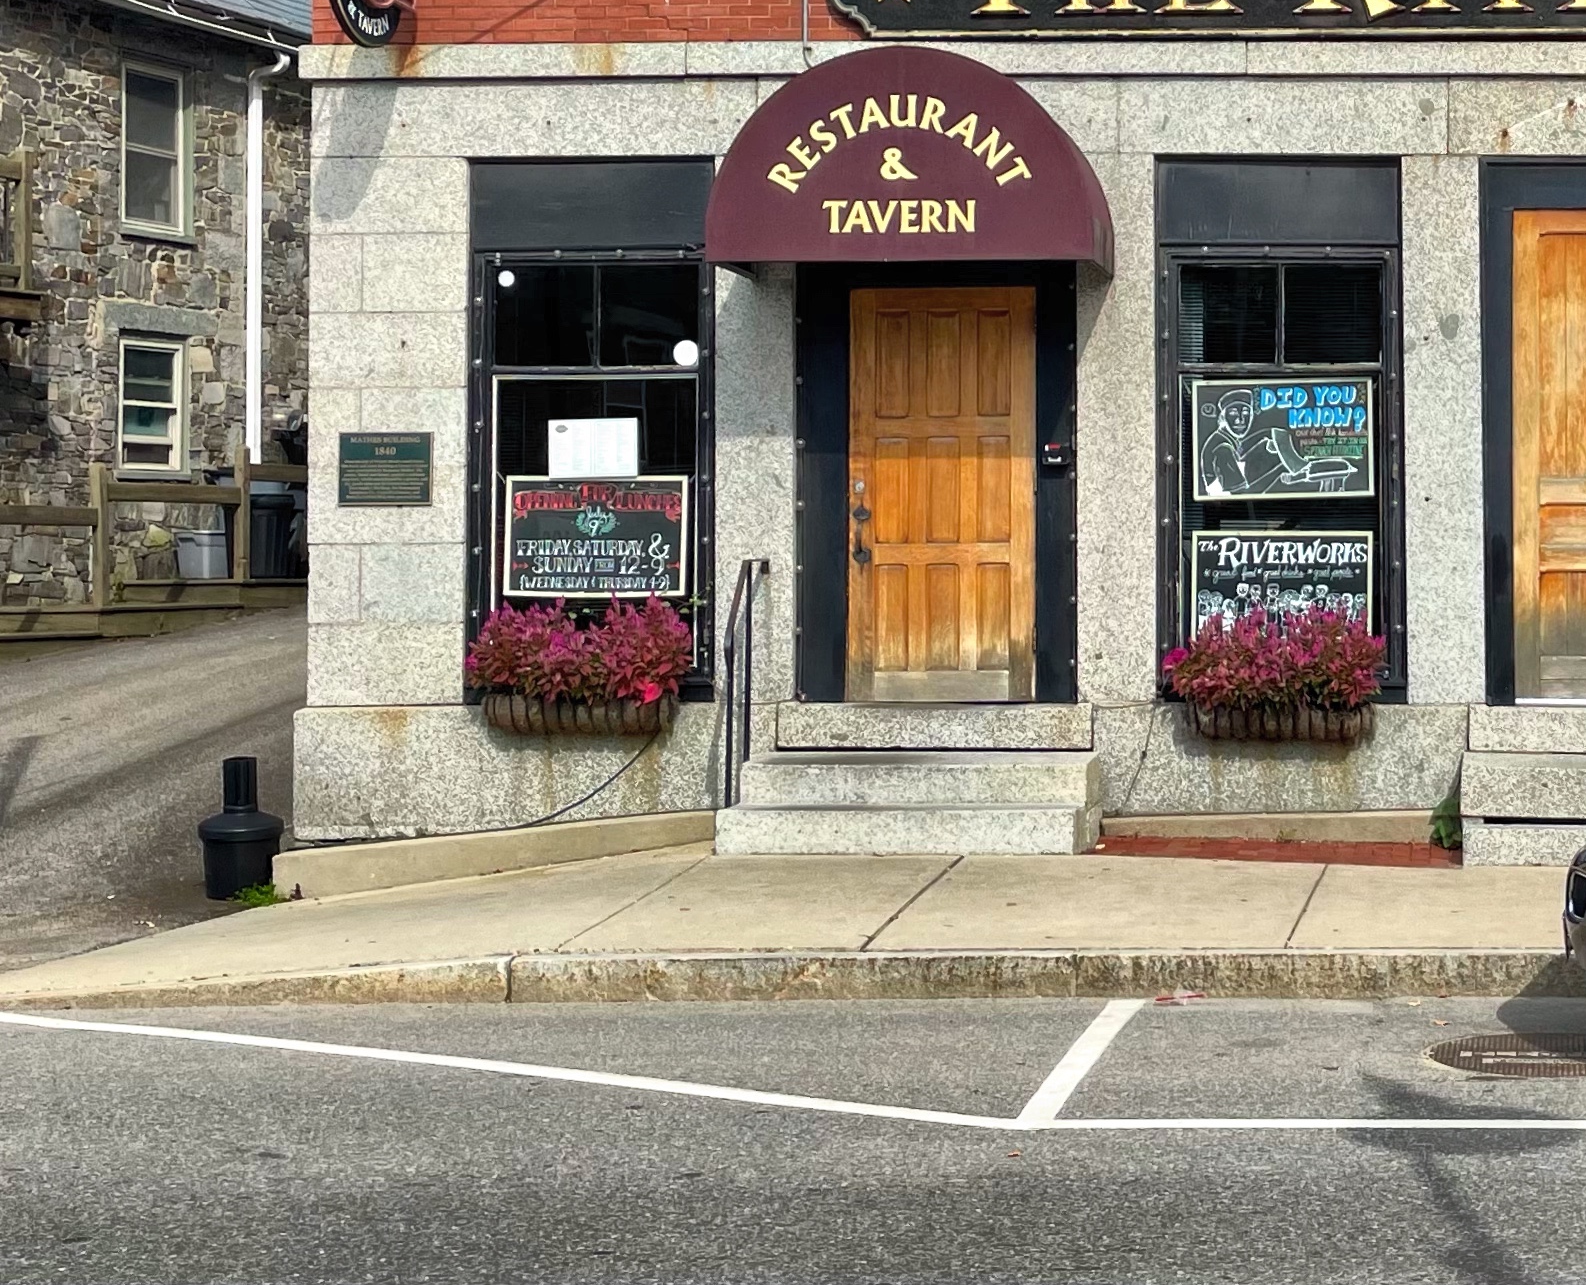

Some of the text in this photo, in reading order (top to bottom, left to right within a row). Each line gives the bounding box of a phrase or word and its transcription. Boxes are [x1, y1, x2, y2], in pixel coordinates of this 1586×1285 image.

[356, 9, 390, 38] TAVERN
[766, 93, 1033, 194] RESTAURANT
[879, 146, 918, 182] &
[822, 198, 977, 235] TAVERN
[1260, 385, 1357, 411] DID YOU
[1288, 405, 1366, 433] KNOW?
[374, 446, 397, 456] 1840
[648, 533, 671, 559] &
[1198, 537, 1369, 569] The RIVERWORKS
[531, 556, 594, 574] SUNDAY
[619, 556, 665, 575] 12-9
[598, 576, 647, 590] THURSDAY
